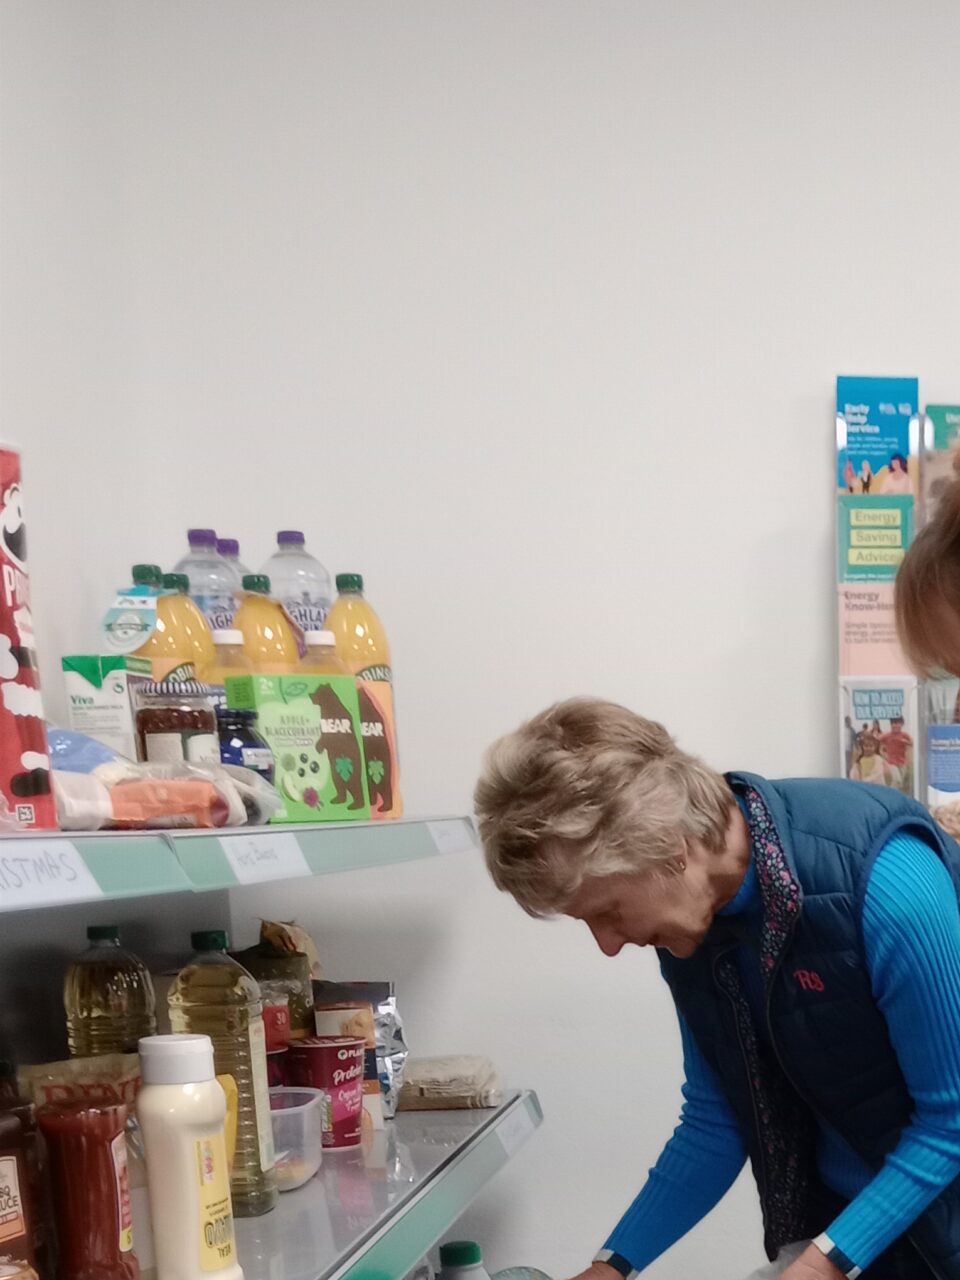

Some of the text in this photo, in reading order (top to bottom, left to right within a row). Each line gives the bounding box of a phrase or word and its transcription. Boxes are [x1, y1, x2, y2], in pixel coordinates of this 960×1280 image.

[854, 512, 898, 524] Energy
[855, 531, 898, 543] Saving
[844, 591, 880, 601] Energy
[70, 695, 95, 705] Viva
[320, 718, 352, 733] BEAR
[360, 721, 385, 737] EAR
